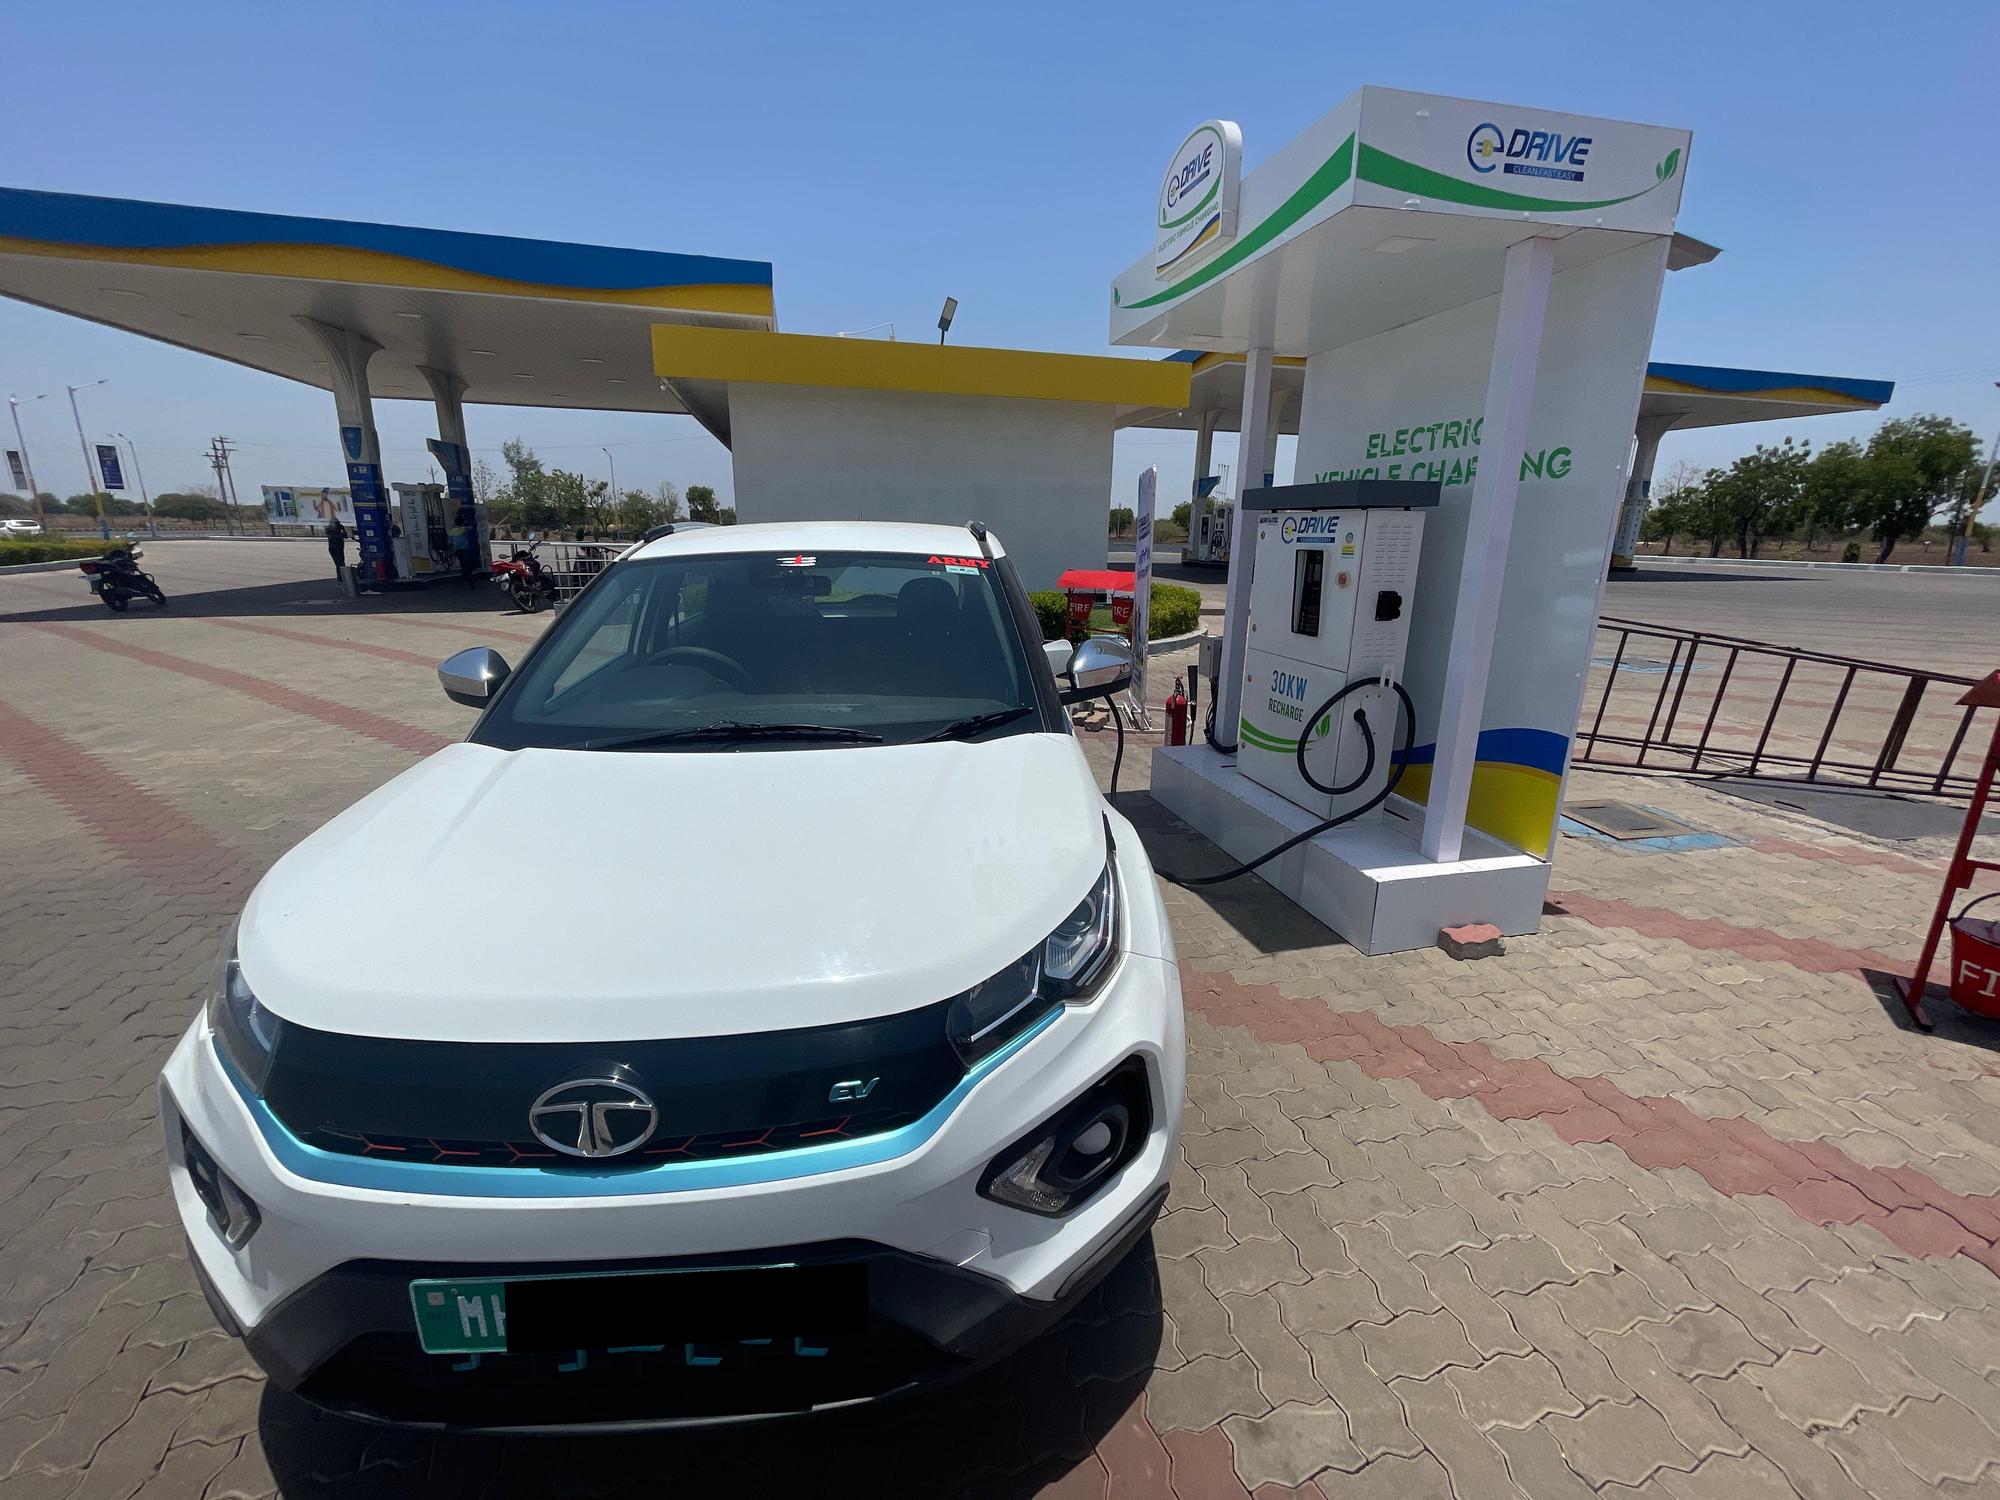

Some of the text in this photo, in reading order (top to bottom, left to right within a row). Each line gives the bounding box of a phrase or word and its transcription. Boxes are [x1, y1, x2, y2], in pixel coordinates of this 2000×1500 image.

[1366, 416, 1485, 459] ELECTRIC
[1409, 447, 1572, 486] CHARNG
[927, 555, 990, 569] ARMY
[1271, 670, 1308, 702] 30KW
[1268, 698, 1305, 723] RECHARGE
[828, 1076, 880, 1103] EV
